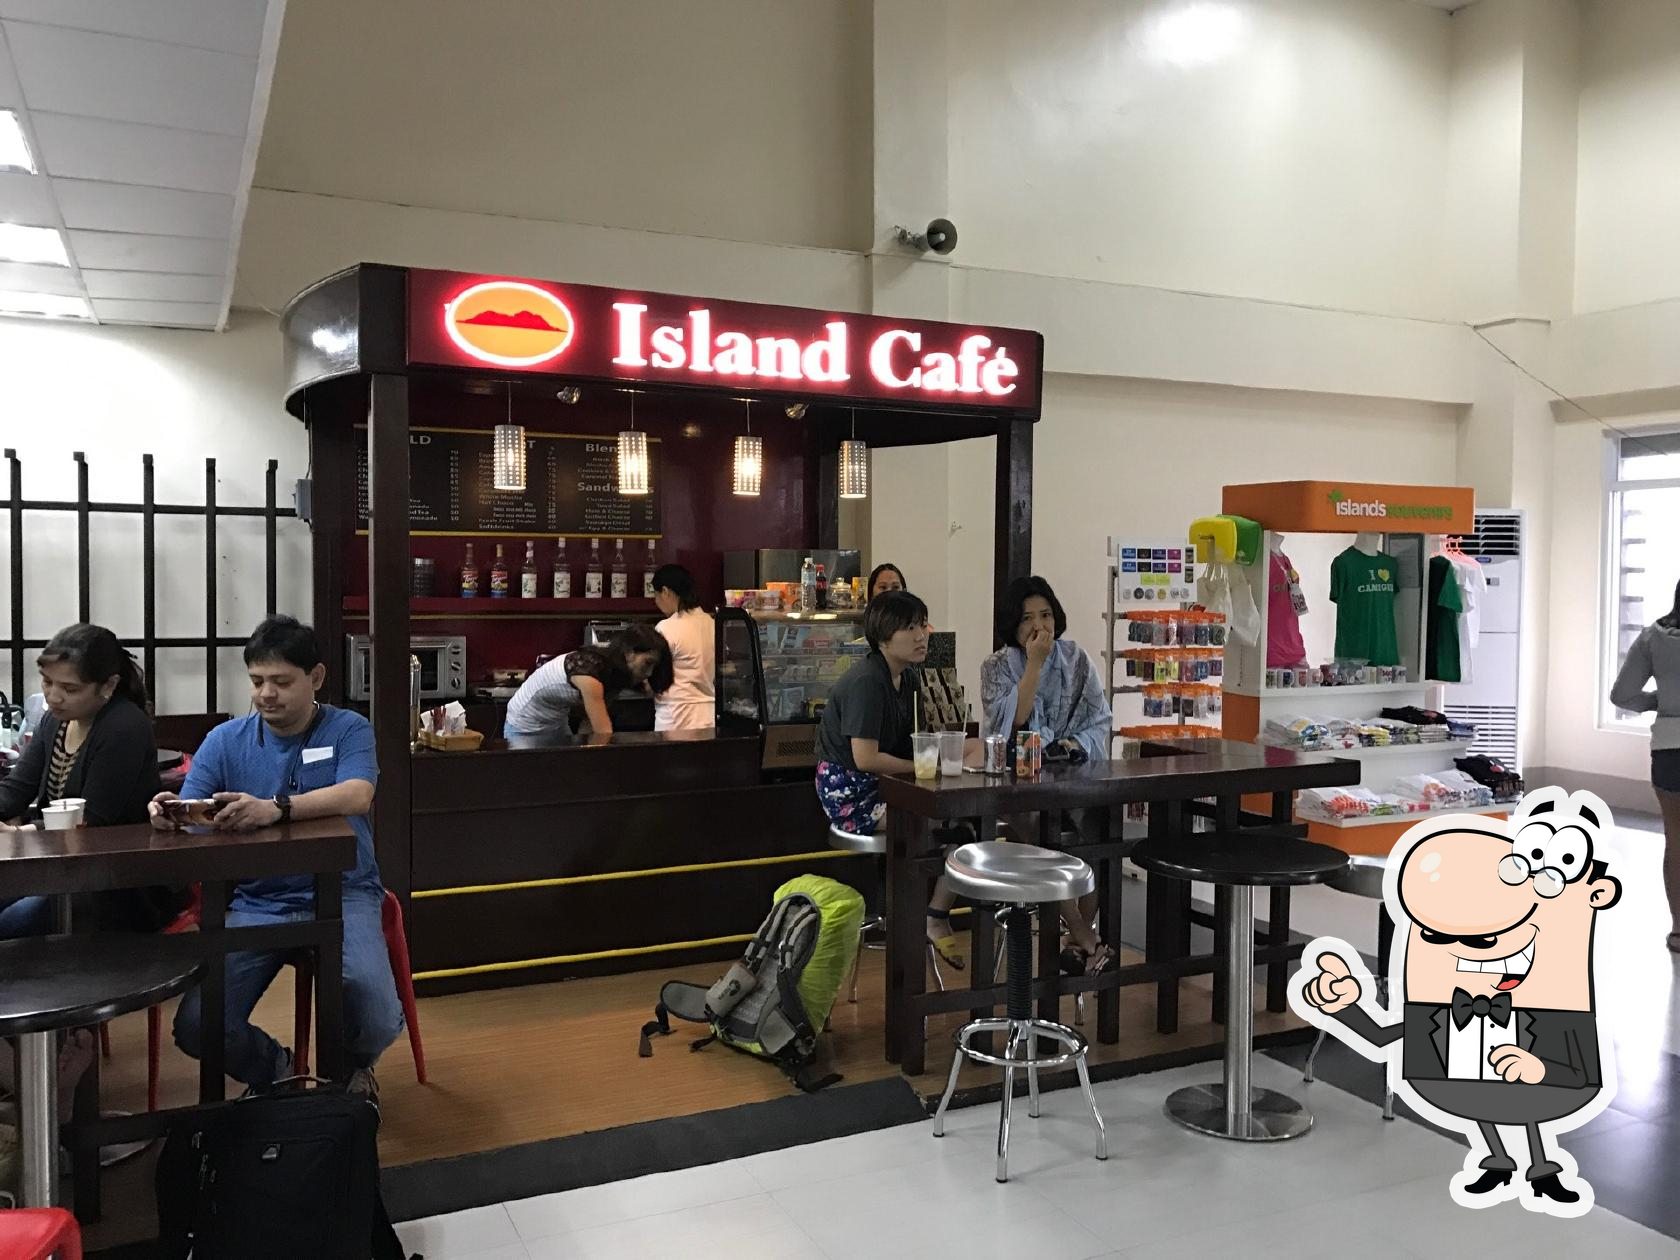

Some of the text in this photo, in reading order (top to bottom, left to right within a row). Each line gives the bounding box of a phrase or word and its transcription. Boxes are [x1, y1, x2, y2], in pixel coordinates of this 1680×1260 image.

[611, 301, 1019, 396] Island Café
[409, 435, 432, 445] LD
[585, 443, 619, 453] Blen
[1336, 499, 1387, 517] islands
[1357, 583, 1394, 593] CAMIGU
